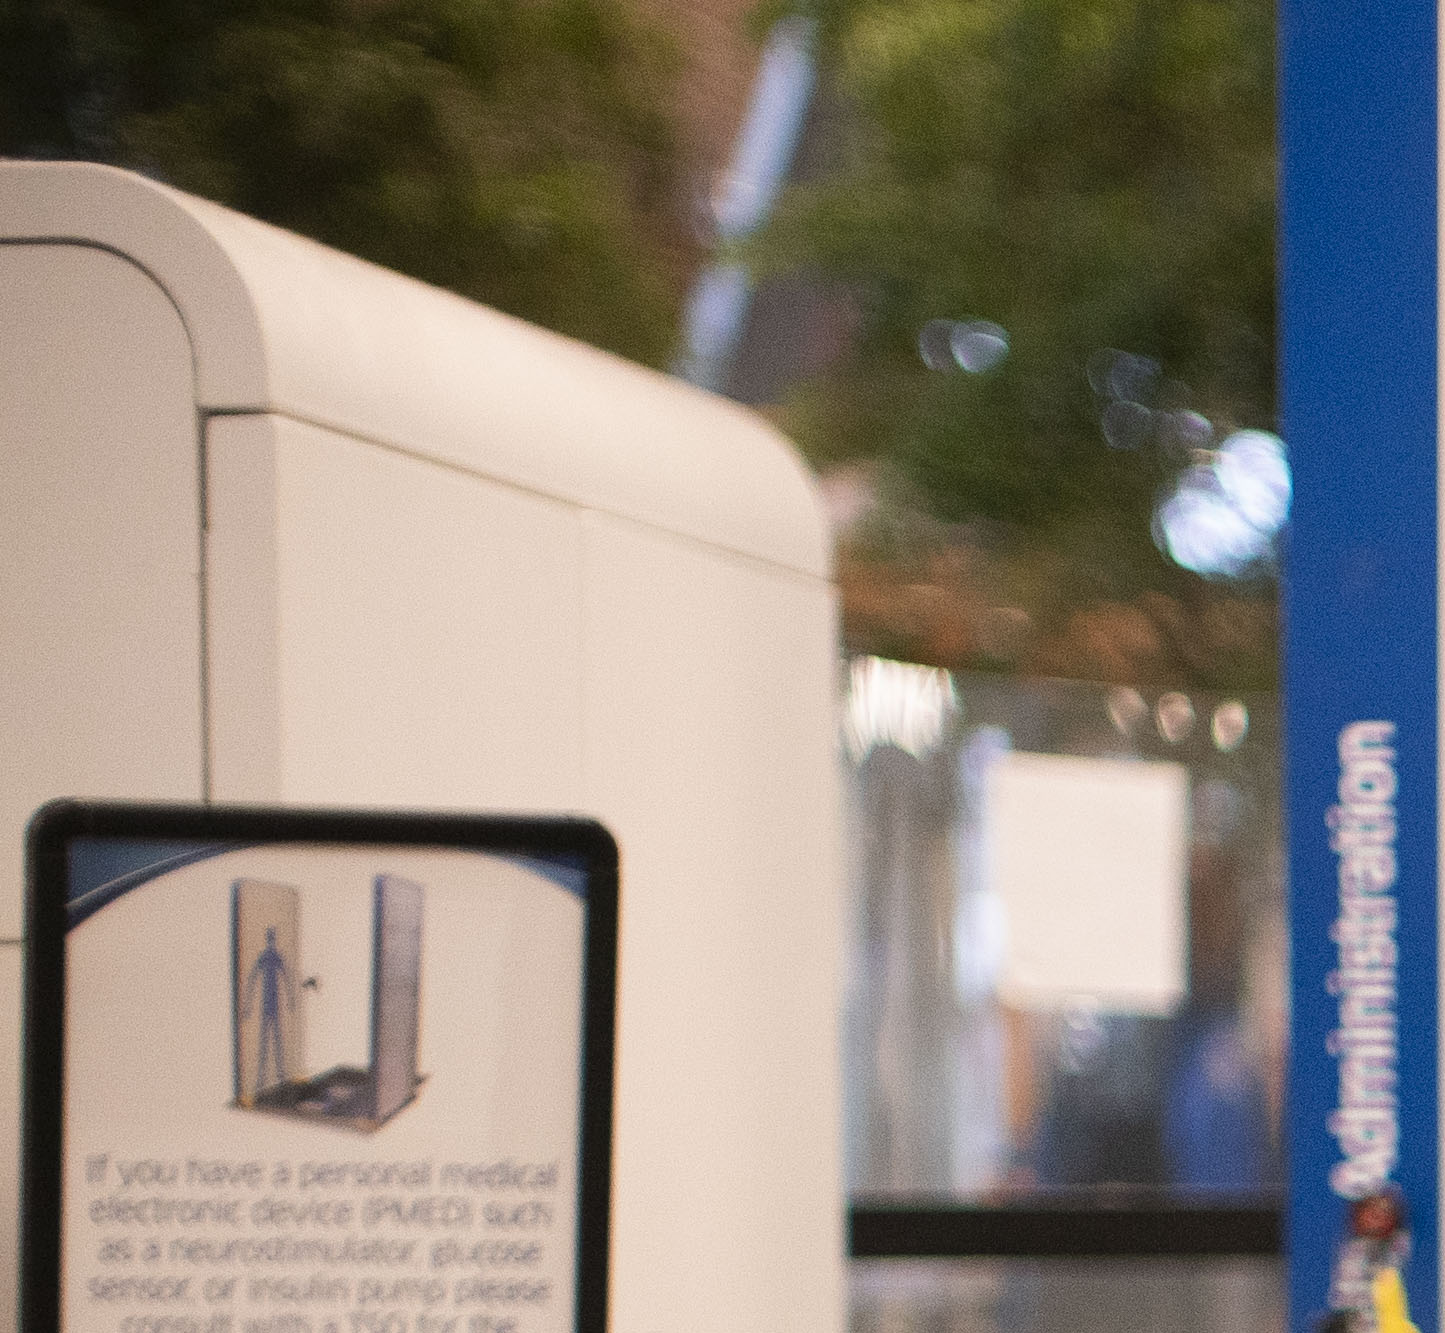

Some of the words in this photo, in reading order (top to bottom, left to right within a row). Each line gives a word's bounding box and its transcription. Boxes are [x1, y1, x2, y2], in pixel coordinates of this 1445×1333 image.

[1325, 720, 1398, 1203] Administration
[86, 1153, 110, 1186] If
[116, 1158, 180, 1193] you
[186, 1154, 264, 1188] have
[272, 1161, 290, 1189] a
[298, 1156, 434, 1193] personal
[440, 1157, 560, 1191] medical
[89, 1194, 244, 1227] electronic
[250, 1195, 353, 1228] device
[482, 1197, 554, 1230] such
[97, 1237, 134, 1264] as
[141, 1237, 161, 1264] a
[430, 1237, 544, 1271] glucose
[203, 1276, 241, 1304] or
[248, 1272, 349, 1305] insulin
[454, 1275, 555, 1308] please
